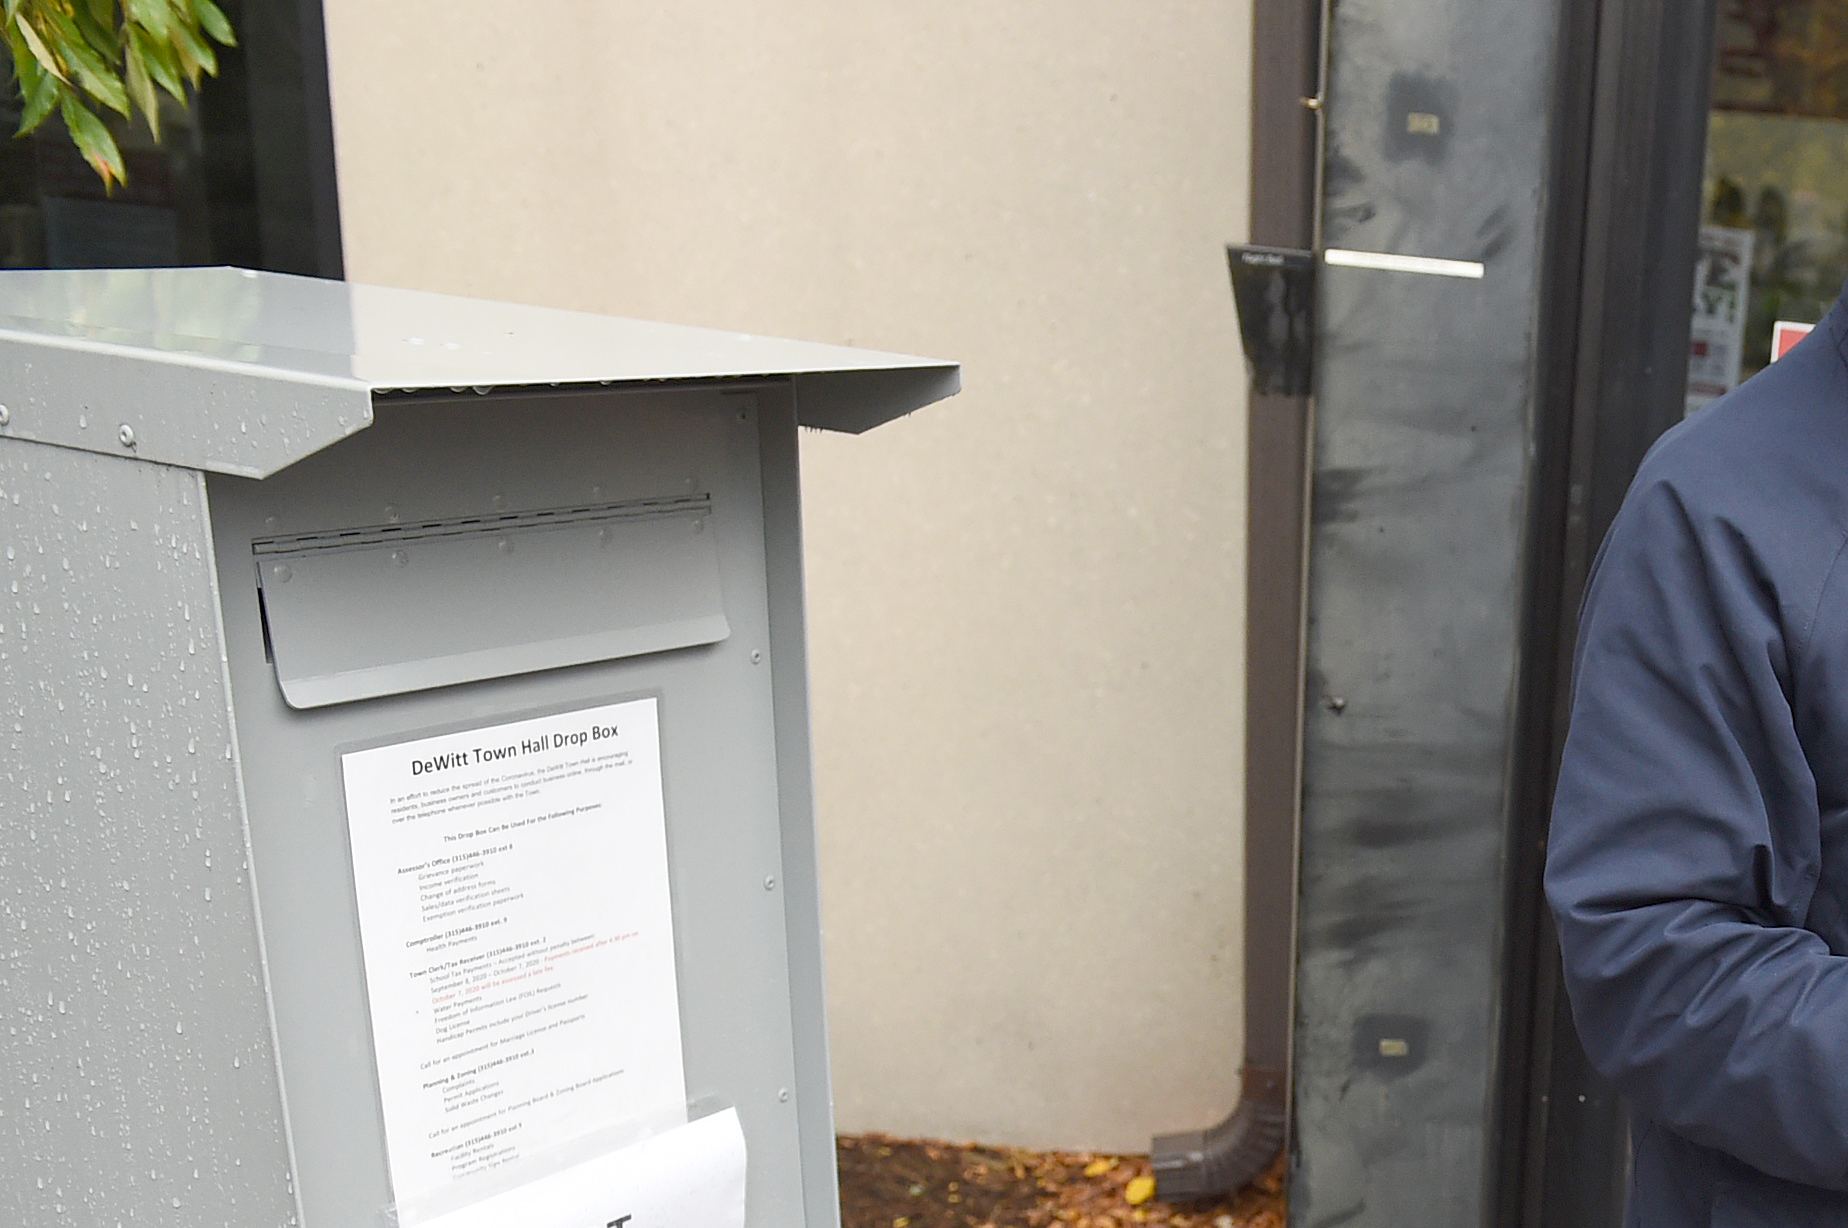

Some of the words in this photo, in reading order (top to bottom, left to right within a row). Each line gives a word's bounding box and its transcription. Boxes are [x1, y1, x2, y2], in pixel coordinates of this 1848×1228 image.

[411, 752, 468, 775] DeWitt
[472, 745, 516, 763] Town
[521, 734, 548, 754] Hall
[553, 731, 587, 748] Drop
[592, 725, 618, 740] Box
[457, 831, 473, 839] Drop
[510, 819, 525, 828] Used
[547, 809, 574, 819] Following
[575, 803, 601, 812] Purposes:
[397, 861, 430, 874] Assessor's
[431, 858, 450, 866] Office
[417, 869, 449, 880] Grievance
[450, 861, 483, 874] paperwork
[418, 881, 442, 890] Income
[443, 873, 478, 885] verification
[420, 891, 443, 901] Change
[453, 884, 476, 894] address
[421, 899, 454, 912] Sales/data
[455, 891, 489, 903] verification
[490, 886, 510, 895] sheets
[422, 909, 456, 922] Exemption
[457, 901, 491, 913] verification
[492, 892, 523, 906] paperwork
[405, 934, 443, 947] Comptroller
[490, 918, 500, 926] ext.
[426, 943, 446, 952] Health
[447, 935, 477, 946] Payments
[409, 970, 426, 978] Town
[428, 961, 457, 973] Clerk/Tax
[459, 954, 484, 964] Receiver
[433, 1004, 451, 1013] Water
[453, 996, 482, 1007] Payments
[434, 1012, 461, 1023] Freedom
[469, 999, 504, 1013] Information
[518, 989, 535, 999] (FOIL)
[536, 983, 561, 993] Requests
[435, 1026, 447, 1034] Dog
[448, 1019, 470, 1030] License
[442, 1079, 475, 1093] Complaints
[443, 1092, 462, 1103] Permit
[464, 1081, 499, 1096] Applications
[444, 1103, 459, 1112] Solid
[460, 1098, 478, 1107] Waste
[479, 1090, 503, 1101] Changes
